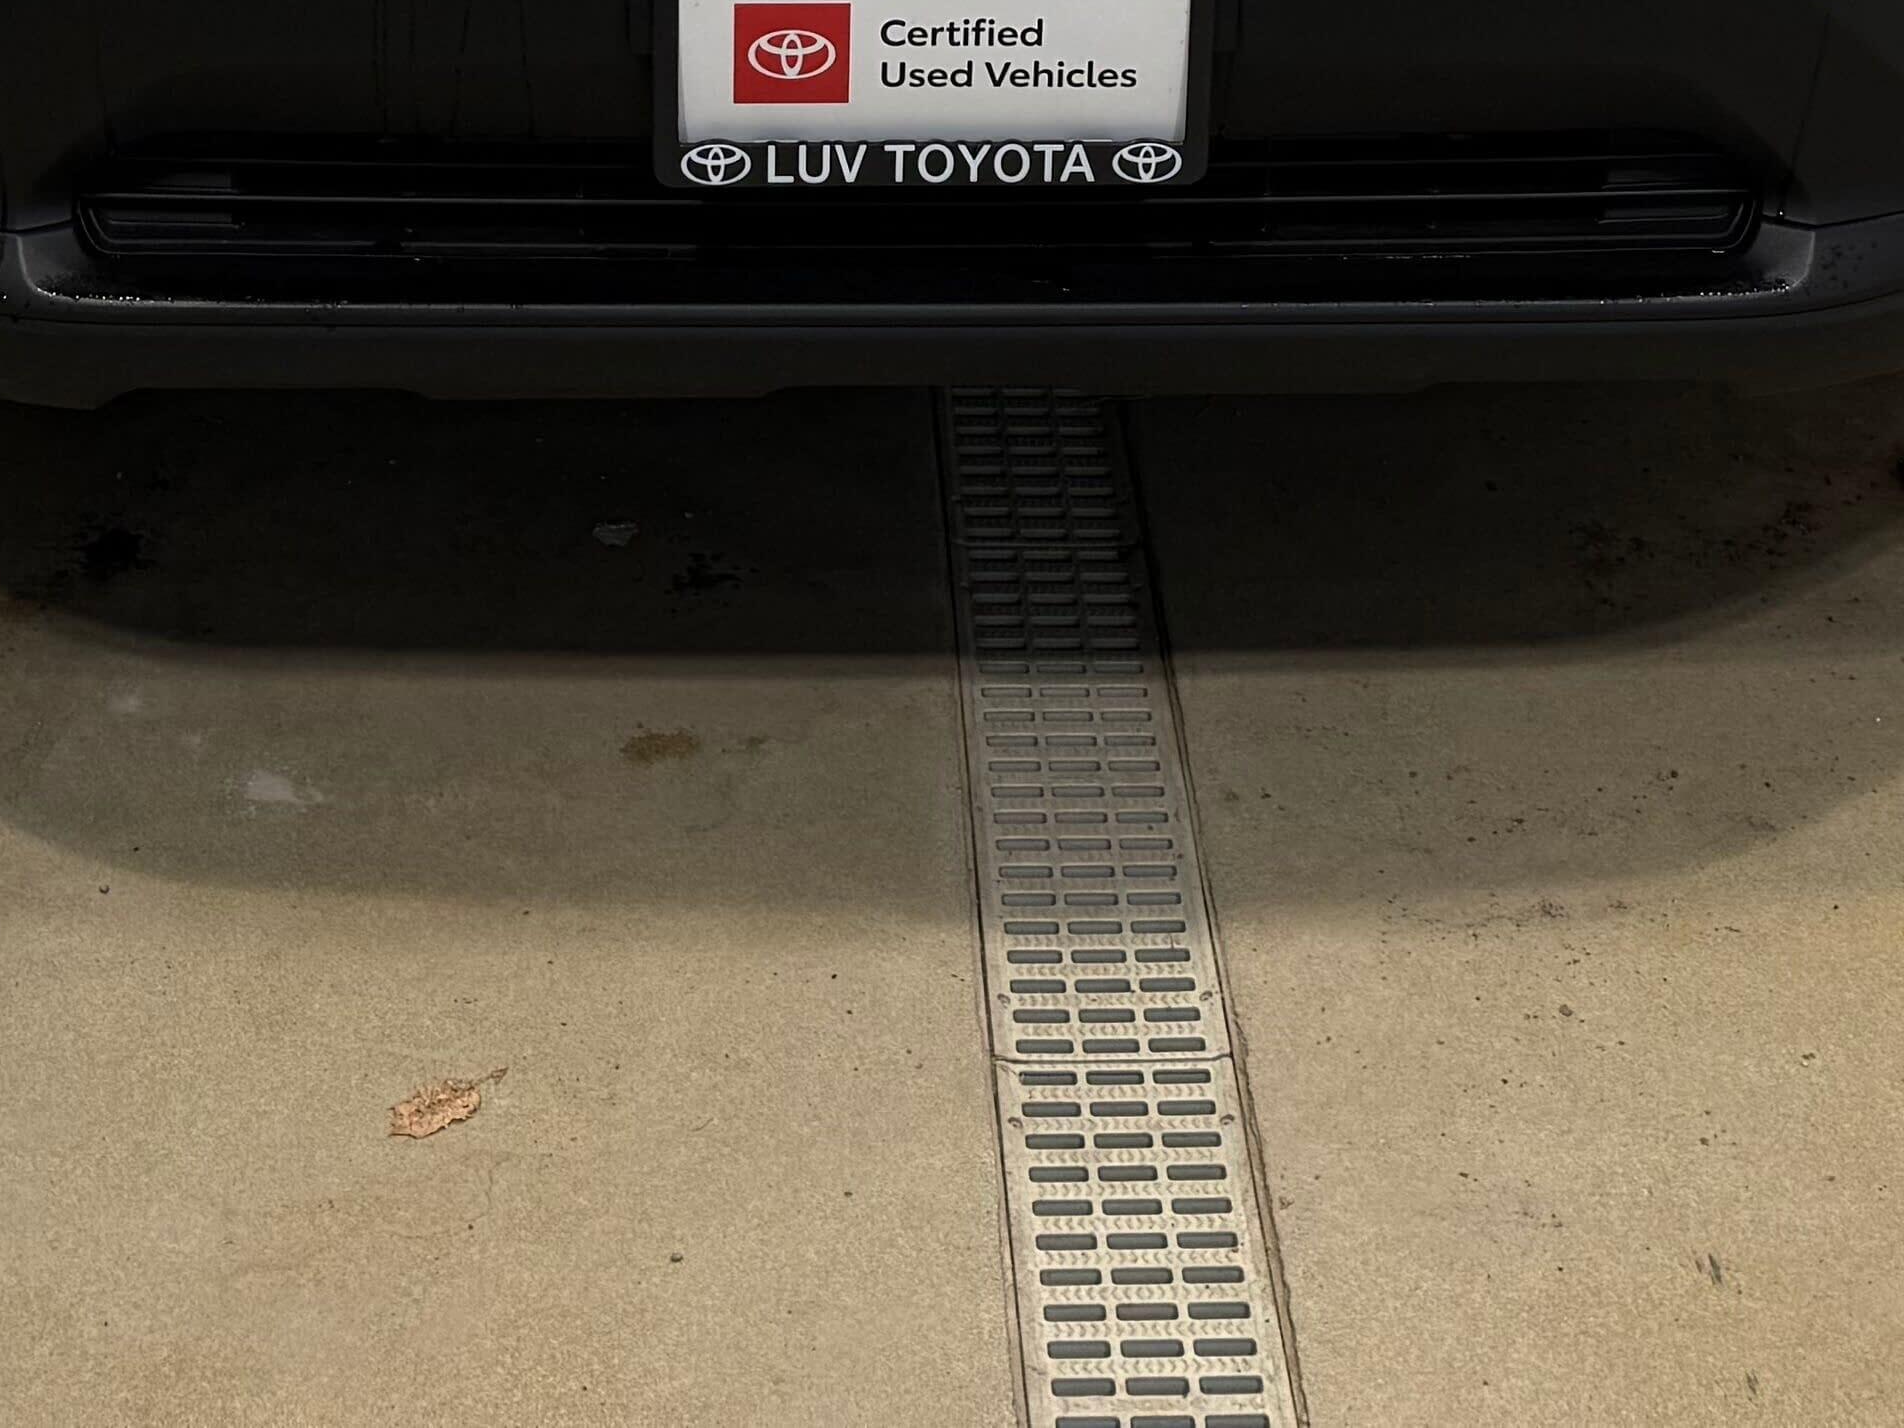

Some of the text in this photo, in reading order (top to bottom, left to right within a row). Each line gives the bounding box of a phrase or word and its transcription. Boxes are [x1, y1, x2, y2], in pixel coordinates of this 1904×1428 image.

[880, 18, 1045, 48] Certified
[880, 59, 1138, 89] Used Vehicles
[767, 143, 1095, 184] LUV TOYOTA
